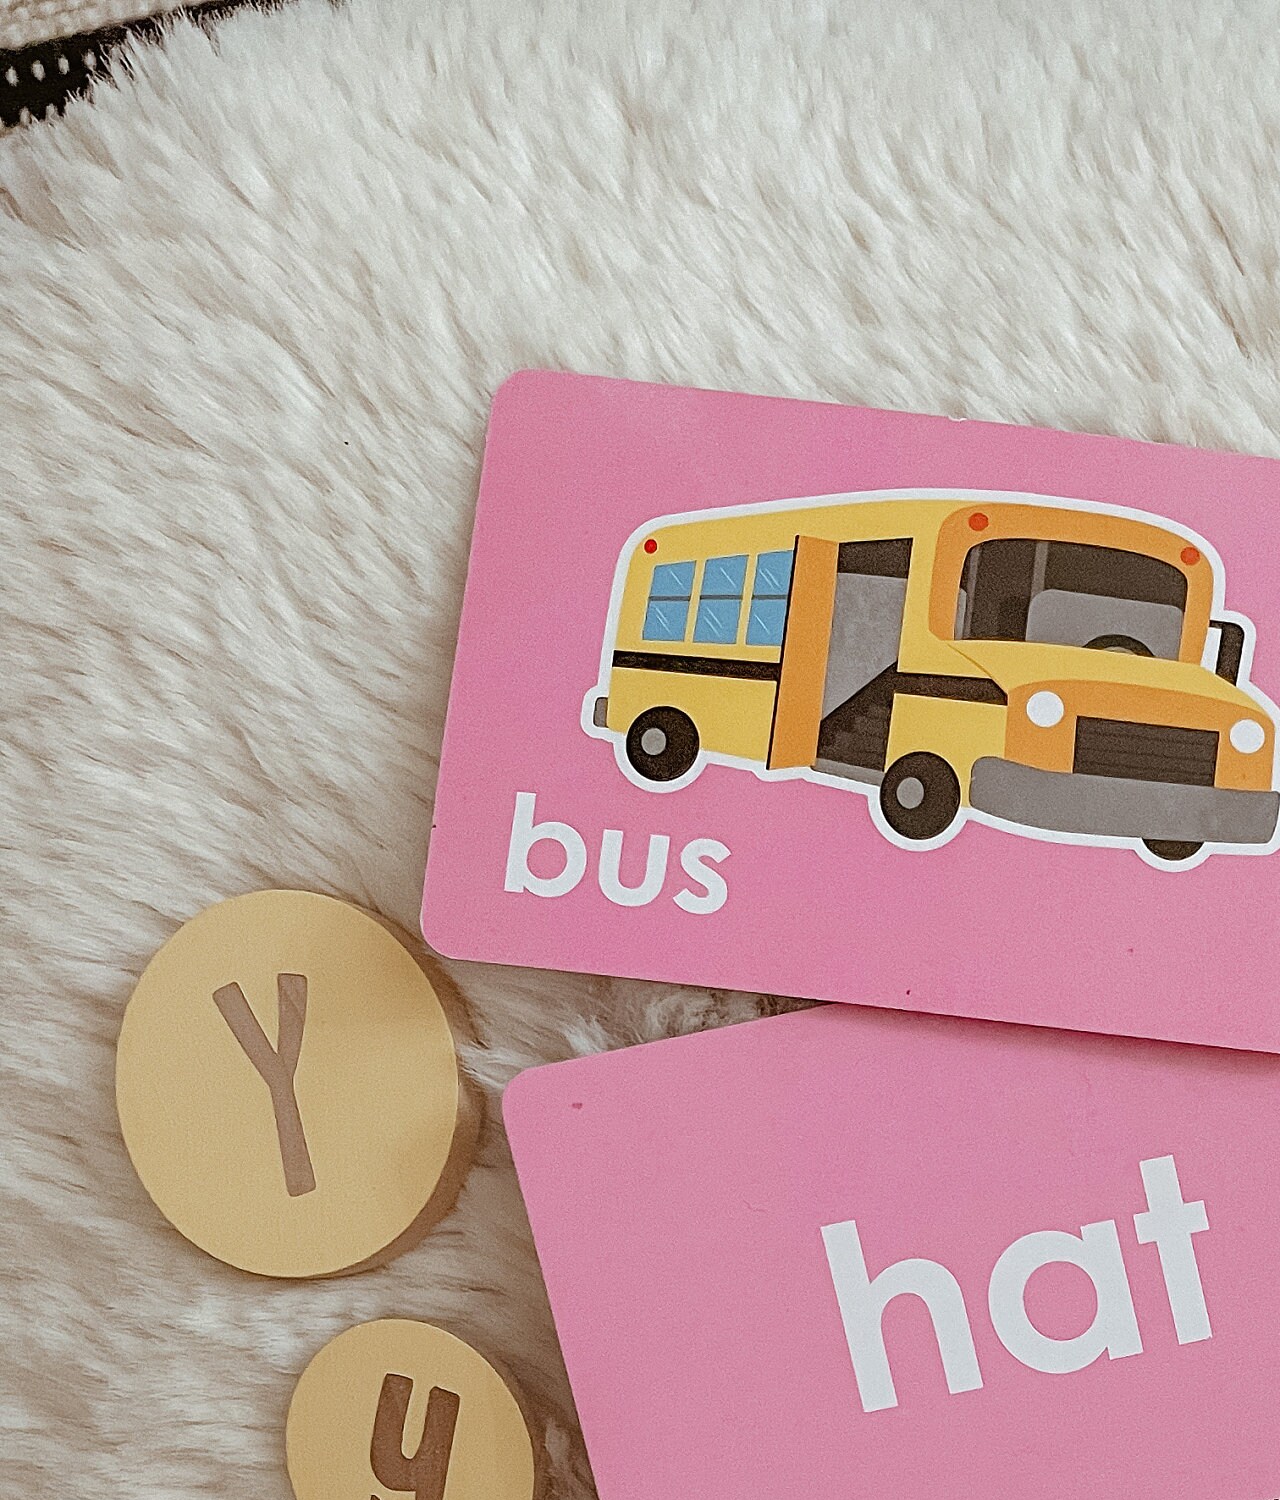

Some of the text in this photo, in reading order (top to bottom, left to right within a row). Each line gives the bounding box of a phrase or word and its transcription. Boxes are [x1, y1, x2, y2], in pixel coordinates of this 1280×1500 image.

[504, 791, 732, 915] bus
[213, 972, 316, 1197] Y
[820, 1154, 1213, 1413] hat
